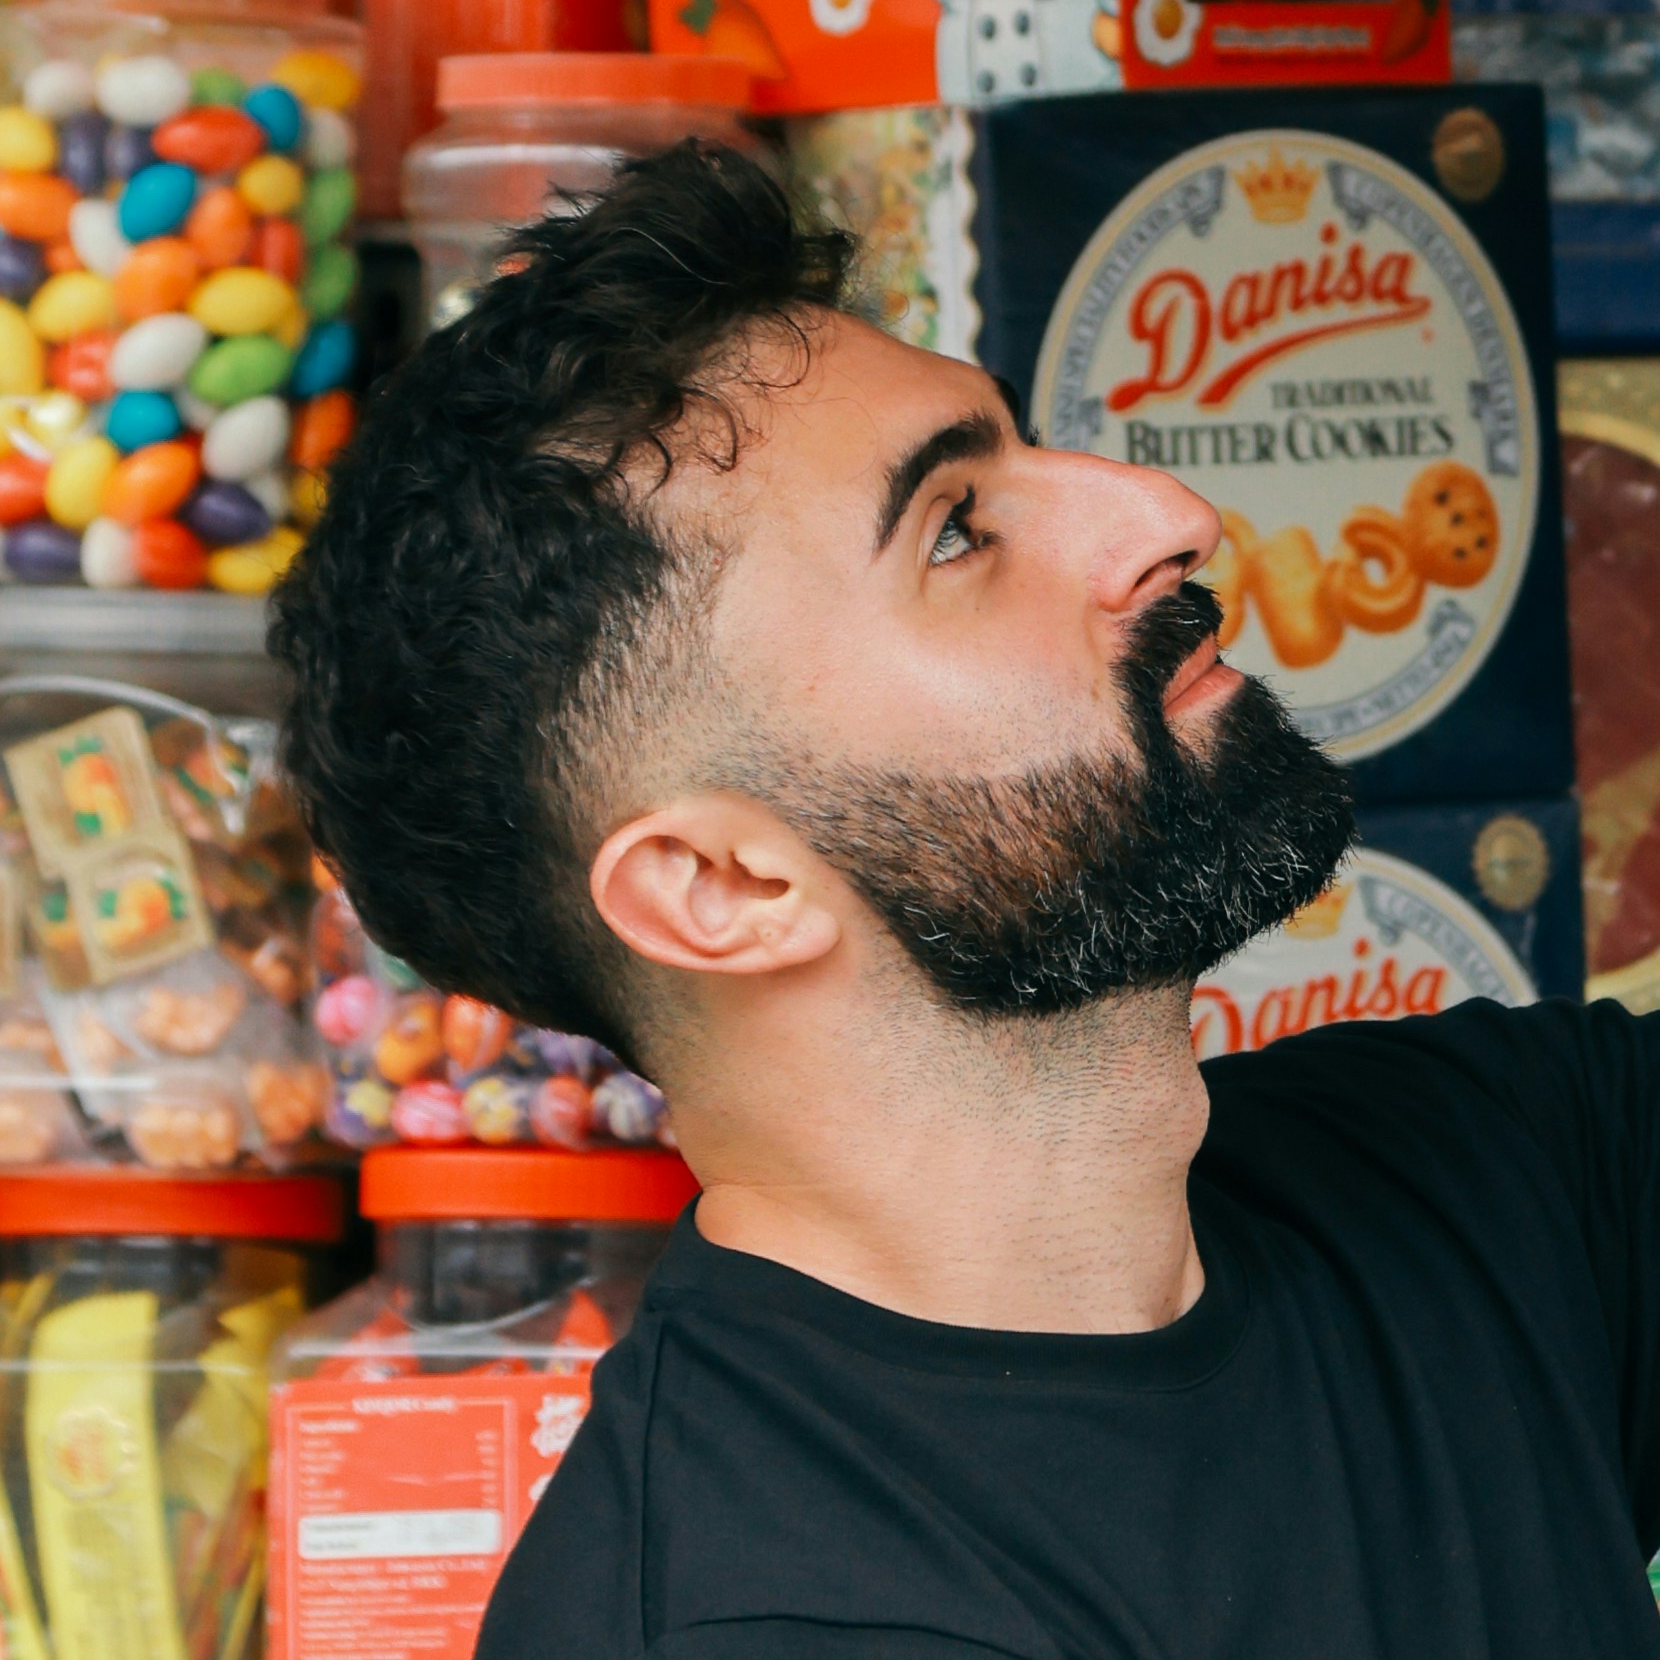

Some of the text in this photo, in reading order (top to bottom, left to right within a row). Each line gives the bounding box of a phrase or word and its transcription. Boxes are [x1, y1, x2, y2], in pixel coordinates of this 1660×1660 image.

[1106, 221, 1432, 412] Danisa
[1271, 375, 1436, 412] TRADITIONAL
[1126, 411, 1456, 468] BUTTER COOKIES
